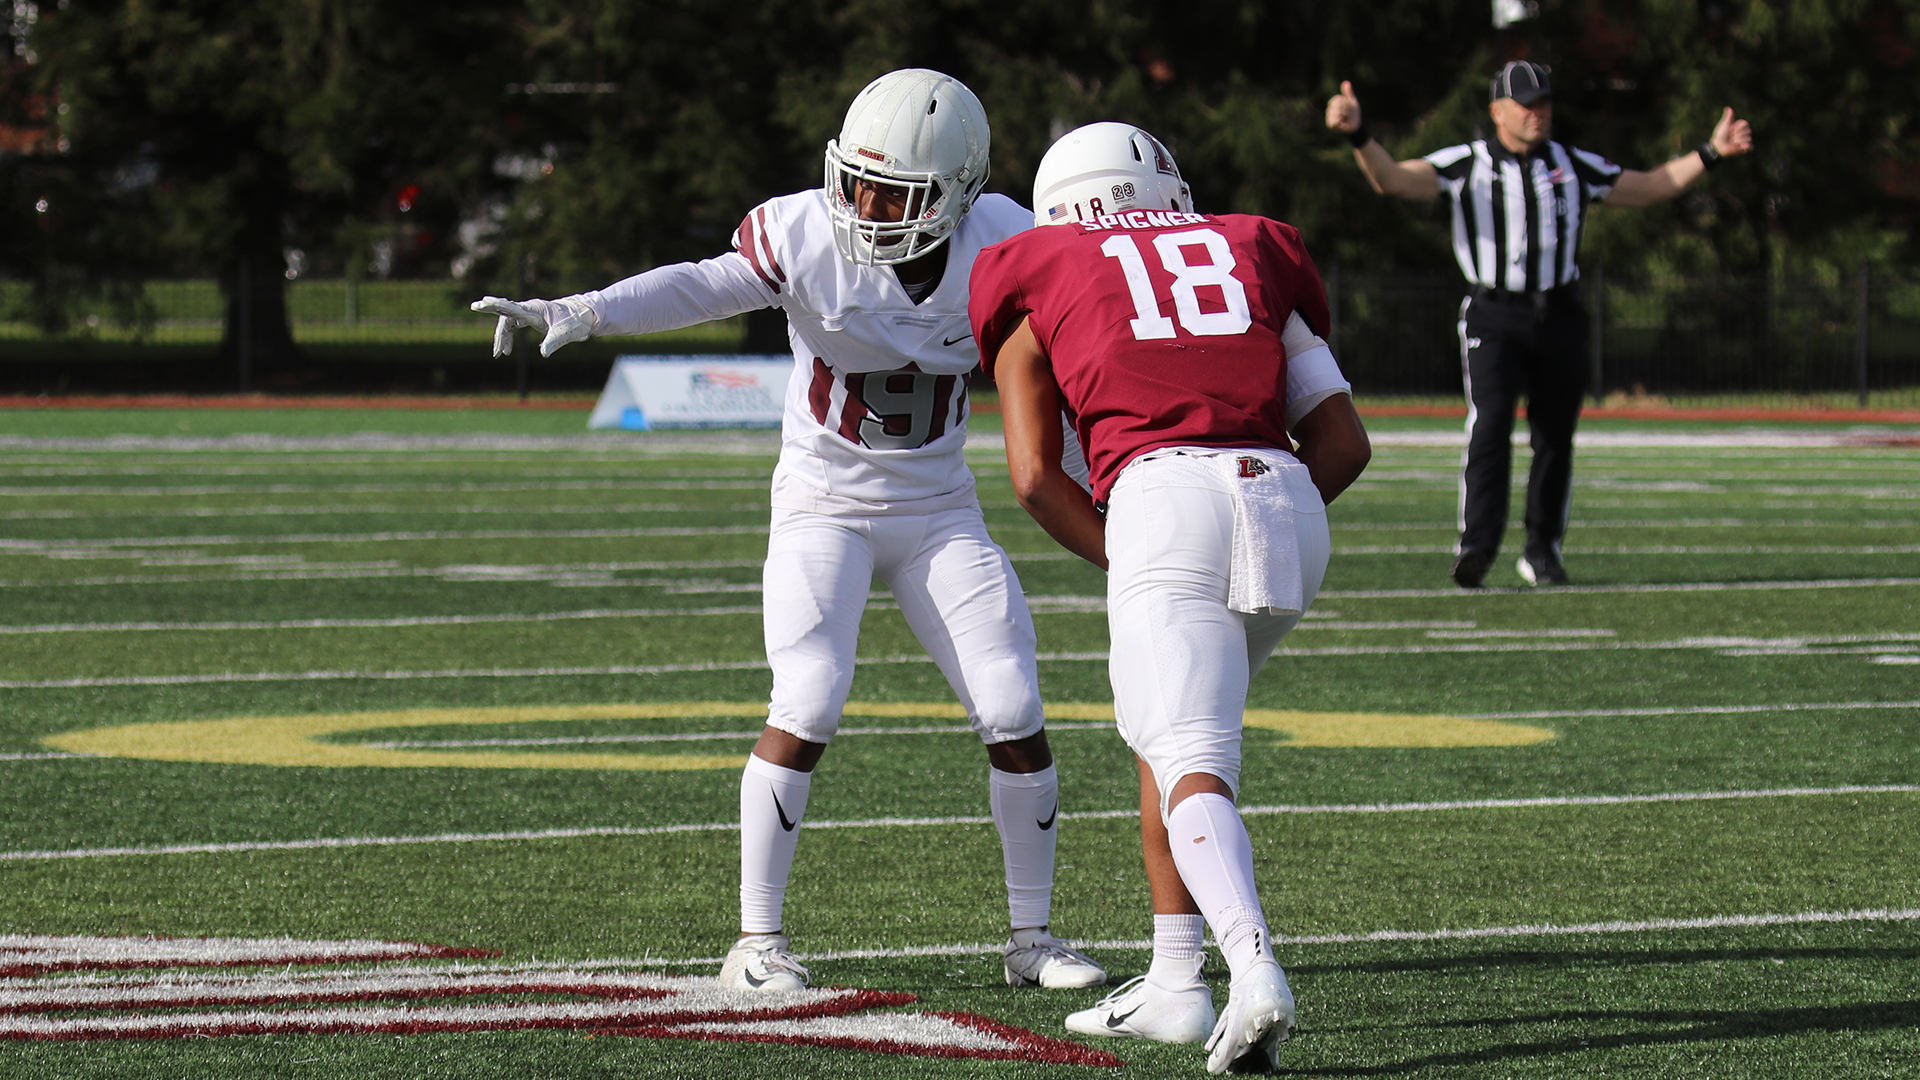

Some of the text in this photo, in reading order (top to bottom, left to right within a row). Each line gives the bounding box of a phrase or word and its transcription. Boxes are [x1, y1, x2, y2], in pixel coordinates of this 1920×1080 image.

[1111, 182, 1135, 201] 23
[1074, 197, 1105, 221] 18
[1079, 211, 1210, 231] SPIGNER
[1100, 228, 1252, 340] 18
[857, 370, 938, 450] 9
